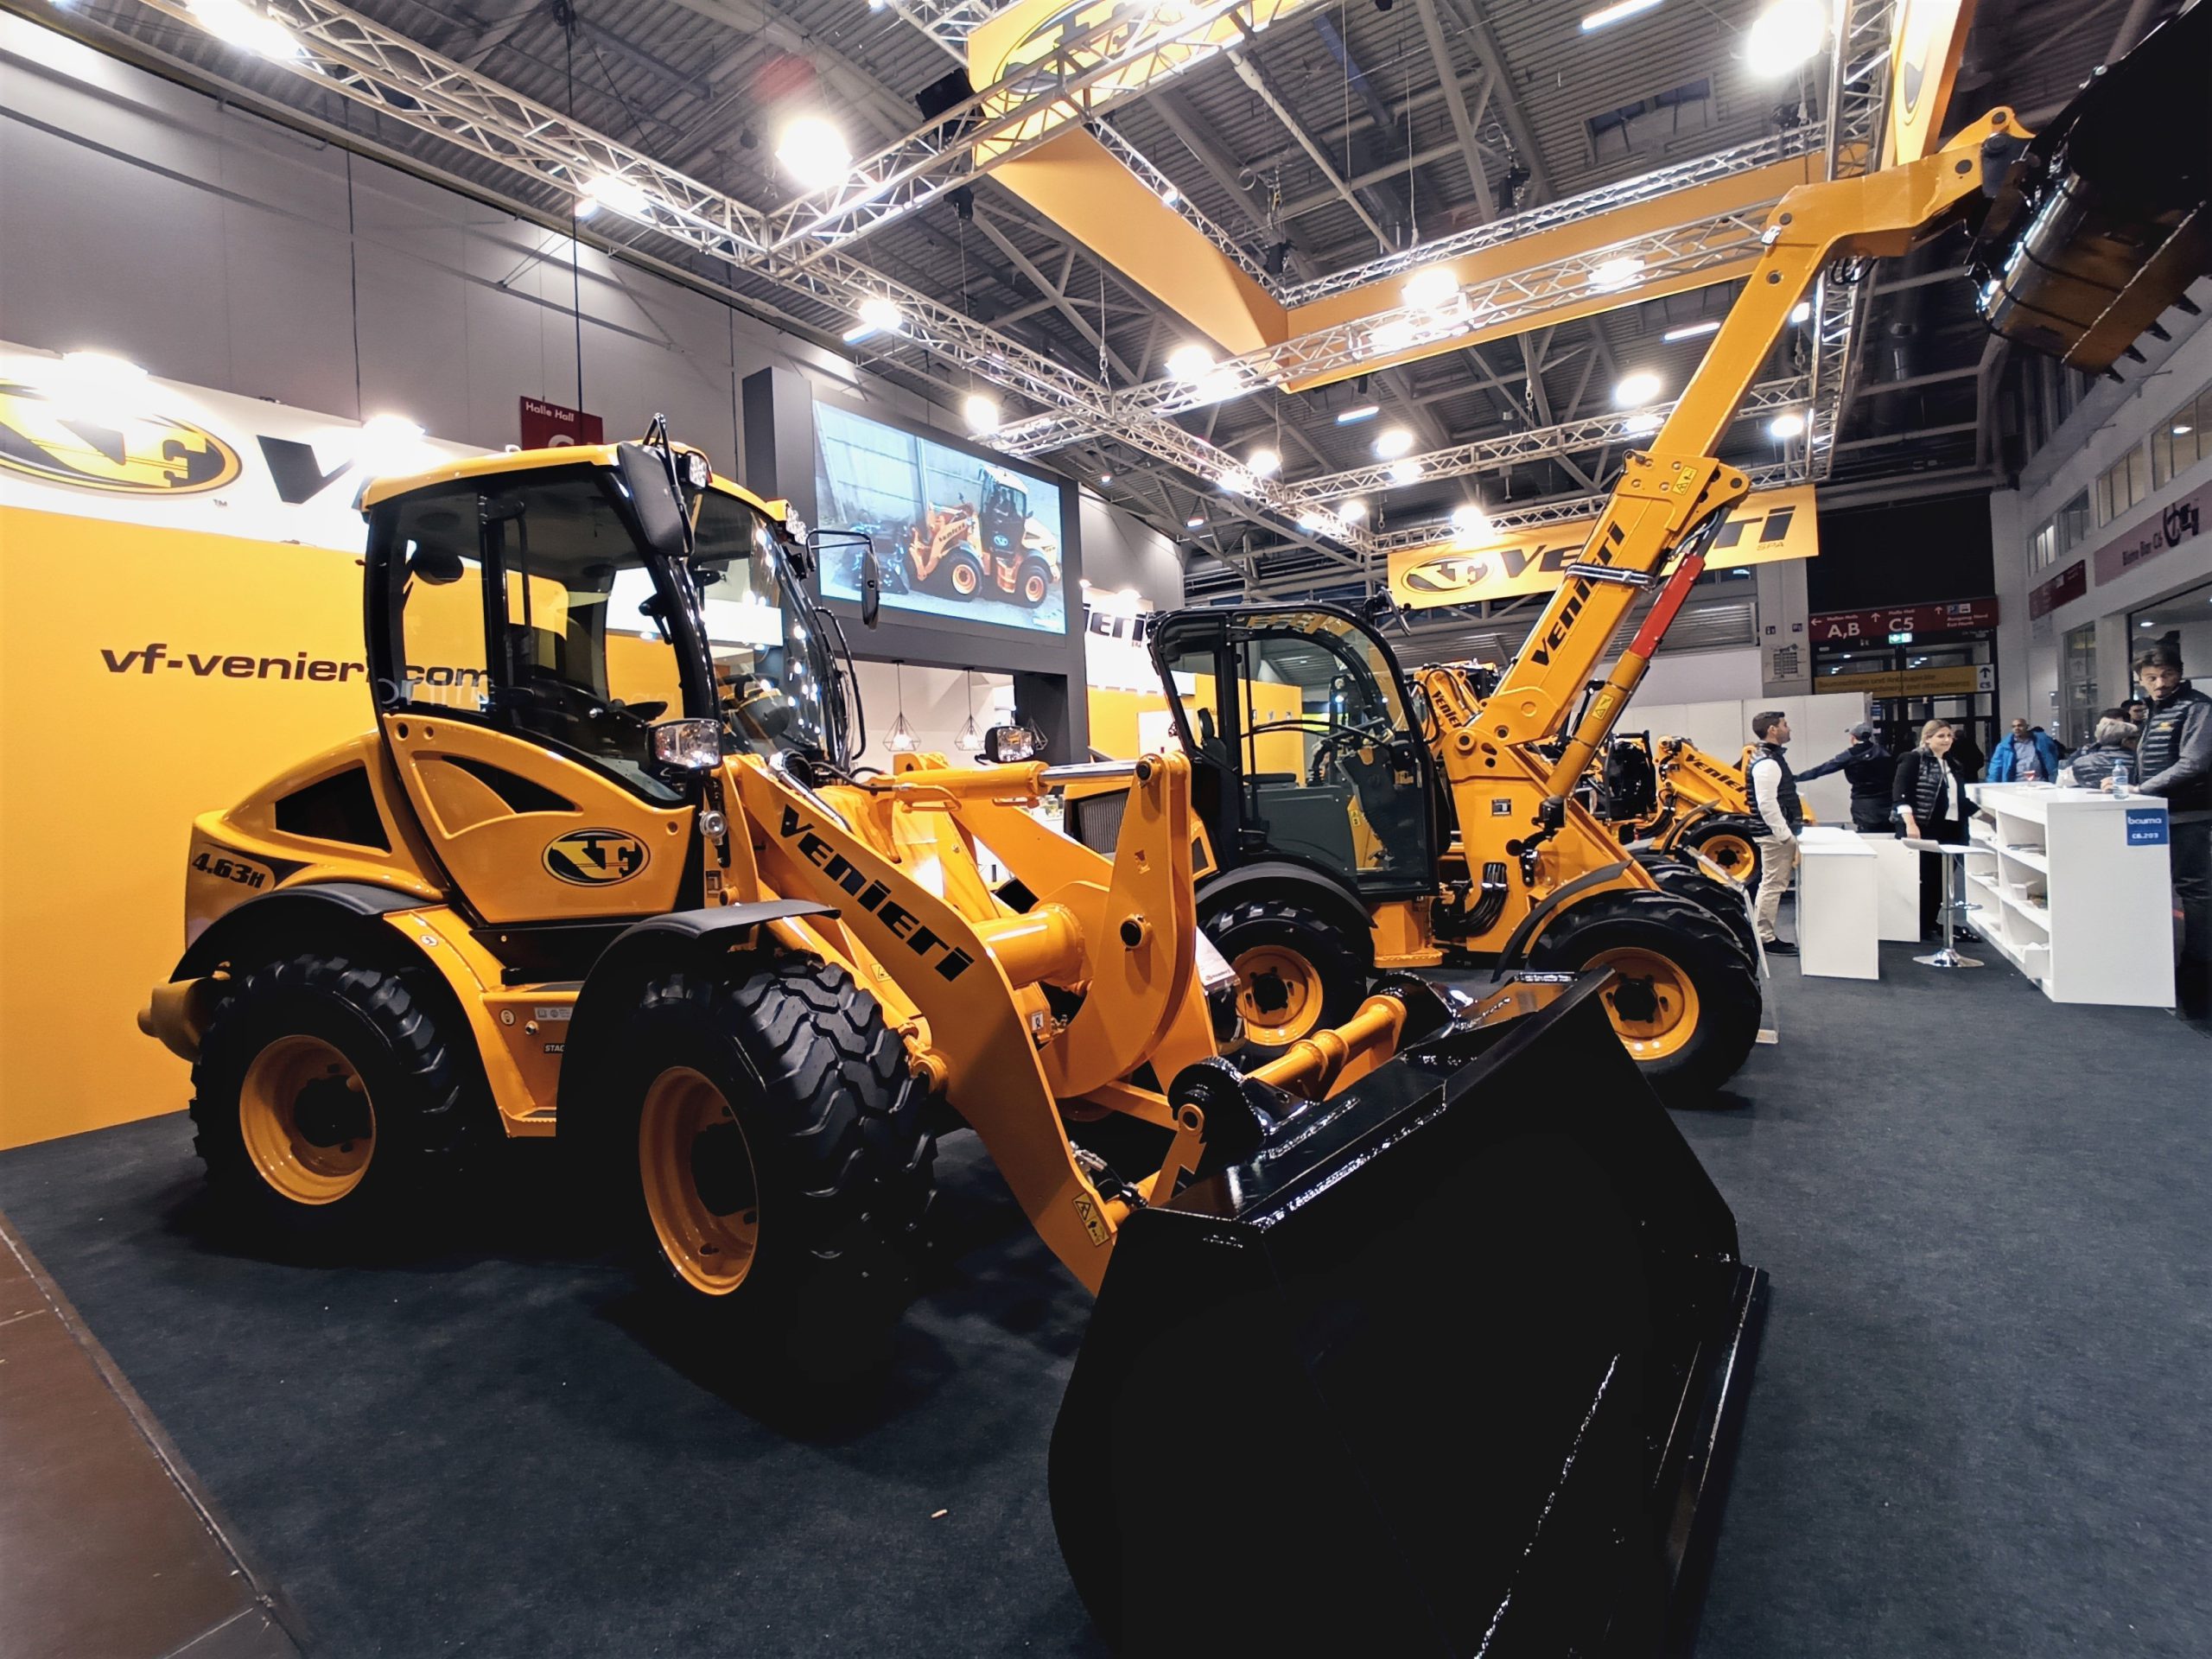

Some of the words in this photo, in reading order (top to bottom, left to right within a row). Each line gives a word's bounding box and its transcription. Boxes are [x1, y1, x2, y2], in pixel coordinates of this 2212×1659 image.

[525, 402, 552, 416] Halle
[555, 410, 575, 422] Hall
[1827, 622, 1860, 639] A,B
[1889, 617, 1915, 632] C5
[1432, 690, 1463, 728] Venier
[1685, 753, 1746, 792] Venier
[780, 804, 975, 982] Venieri
